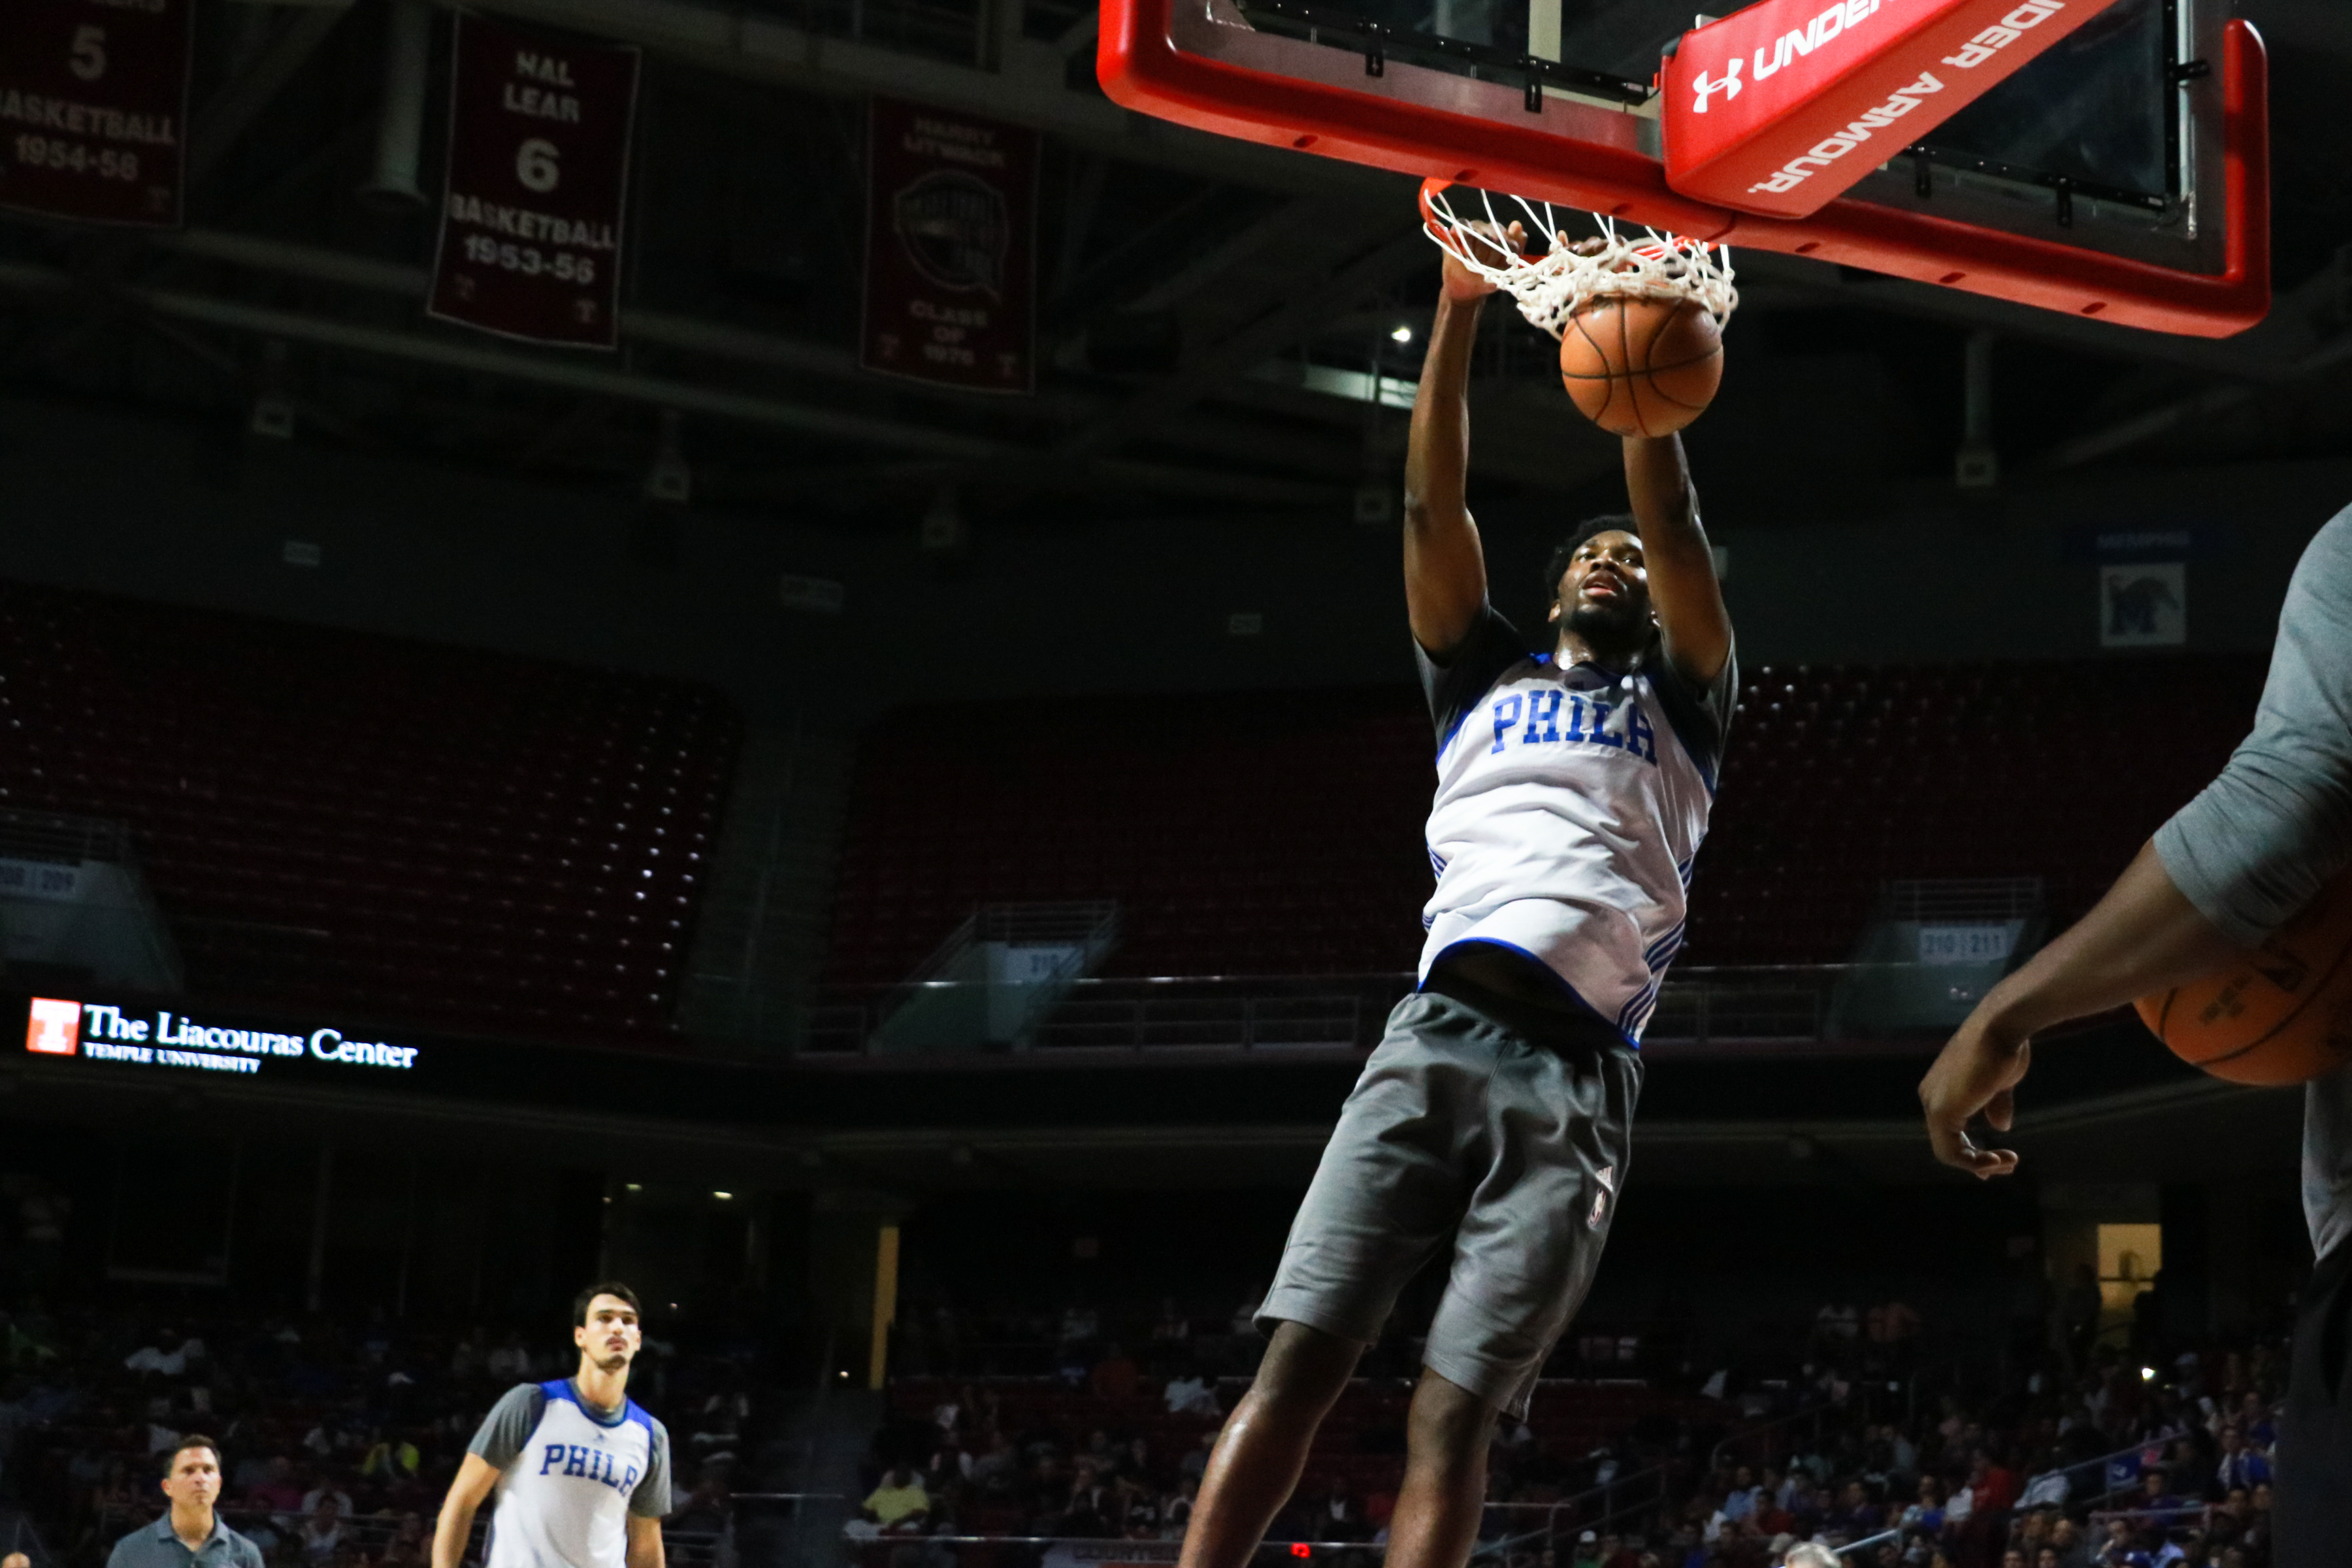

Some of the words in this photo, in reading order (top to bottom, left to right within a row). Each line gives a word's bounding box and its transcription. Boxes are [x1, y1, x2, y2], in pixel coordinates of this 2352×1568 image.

[69, 24, 107, 80] 5
[0, 88, 176, 146] ASKETBALL
[504, 82, 580, 123] LEAR
[515, 137, 560, 193] 6
[449, 193, 615, 250] BASKETBALL
[1492, 690, 1658, 766] PHILA
[84, 1003, 149, 1041] The
[157, 1011, 304, 1056] Liacouras
[310, 1028, 418, 1068] Center
[84, 1041, 154, 1064] TEMPLE
[158, 1049, 260, 1073] UNIVERSITY
